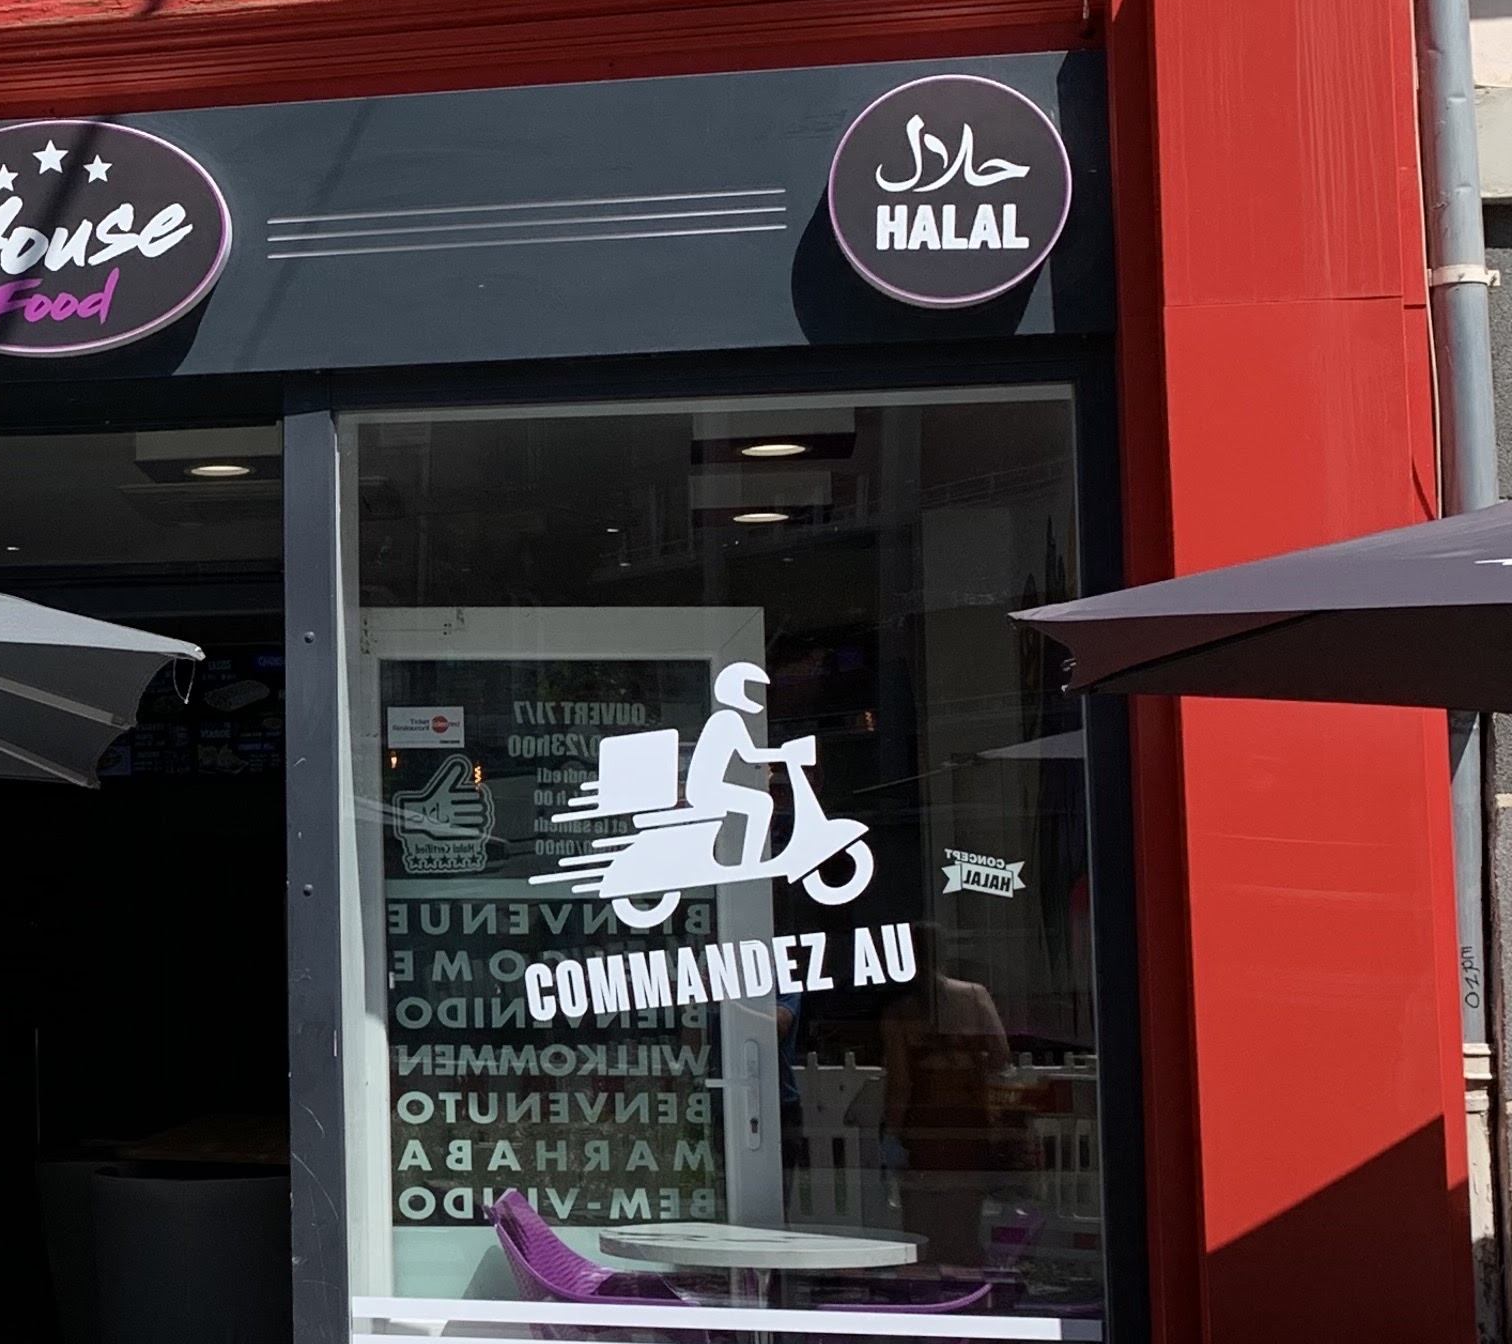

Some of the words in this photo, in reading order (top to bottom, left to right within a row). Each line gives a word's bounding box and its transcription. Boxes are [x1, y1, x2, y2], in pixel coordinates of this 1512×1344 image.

[875, 114, 1030, 192] حلال
[875, 203, 1030, 251] HALAL
[524, 932, 834, 1022] COMMANDEZ
[854, 922, 917, 987] AU
